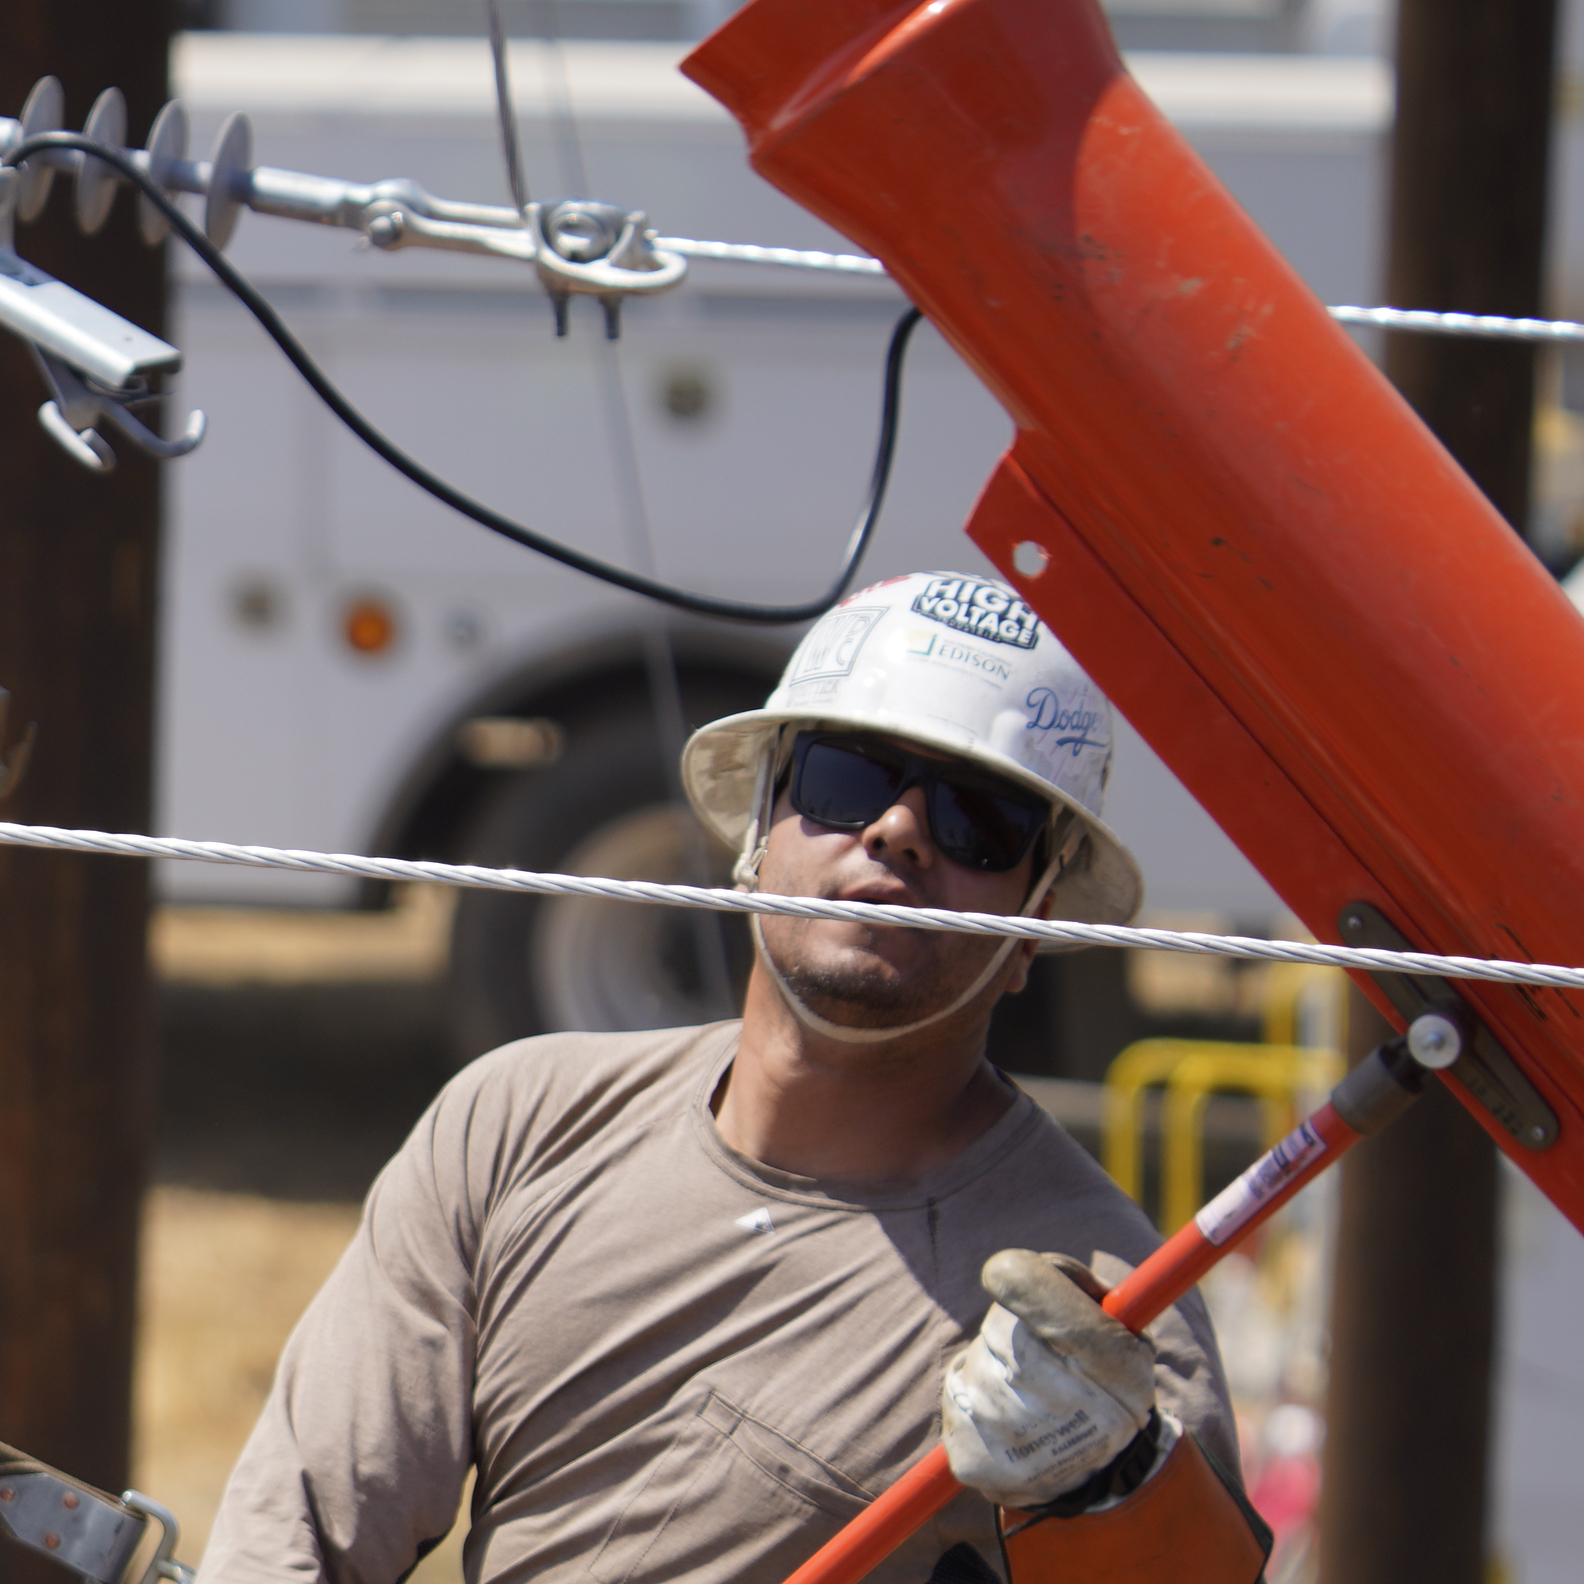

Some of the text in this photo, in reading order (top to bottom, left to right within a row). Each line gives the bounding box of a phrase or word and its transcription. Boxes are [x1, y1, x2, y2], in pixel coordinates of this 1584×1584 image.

[920, 596, 1033, 645] VOLTAGE
[925, 578, 1039, 630] HIGH
[938, 643, 1011, 681] EDISON
[1004, 1408, 1090, 1463] Honeywell
